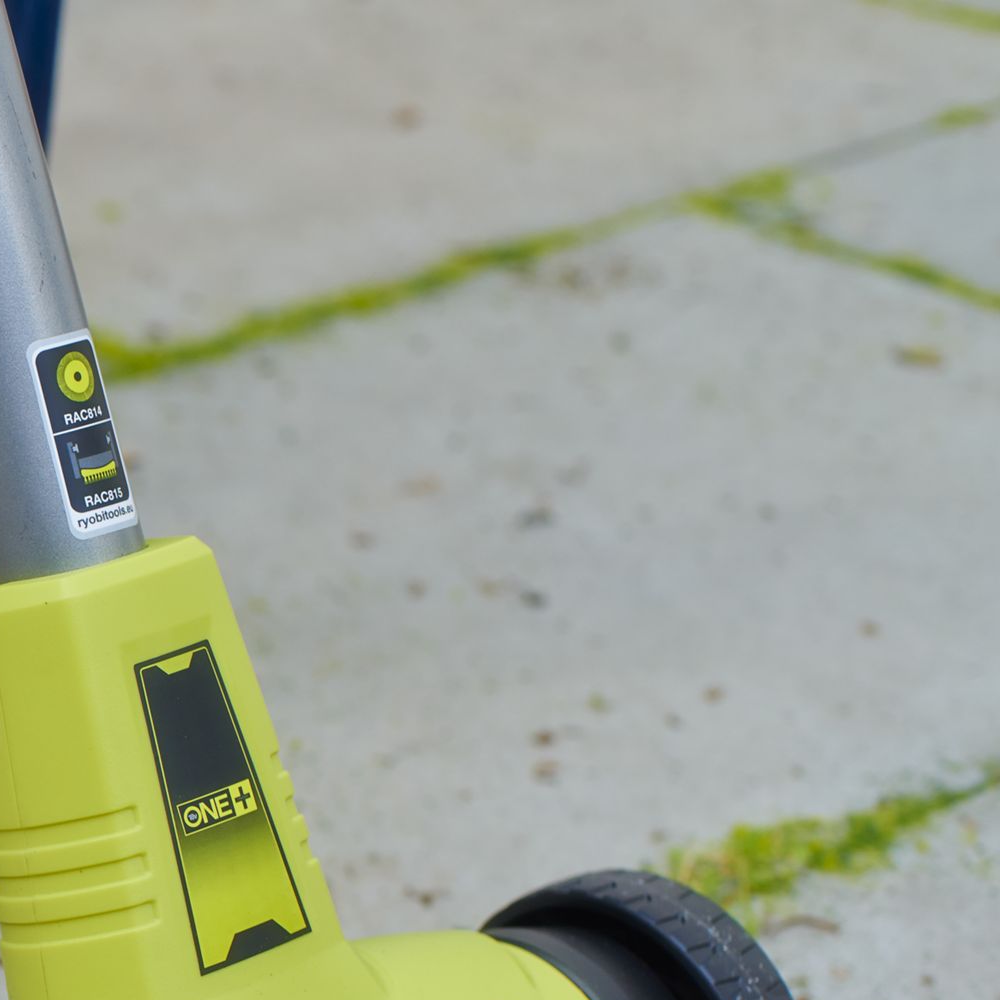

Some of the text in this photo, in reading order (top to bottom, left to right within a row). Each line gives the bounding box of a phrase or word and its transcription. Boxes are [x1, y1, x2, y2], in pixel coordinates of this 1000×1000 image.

[64, 405, 103, 426] RAC814
[84, 487, 124, 508] RAC815
[183, 786, 251, 828] ONE+
